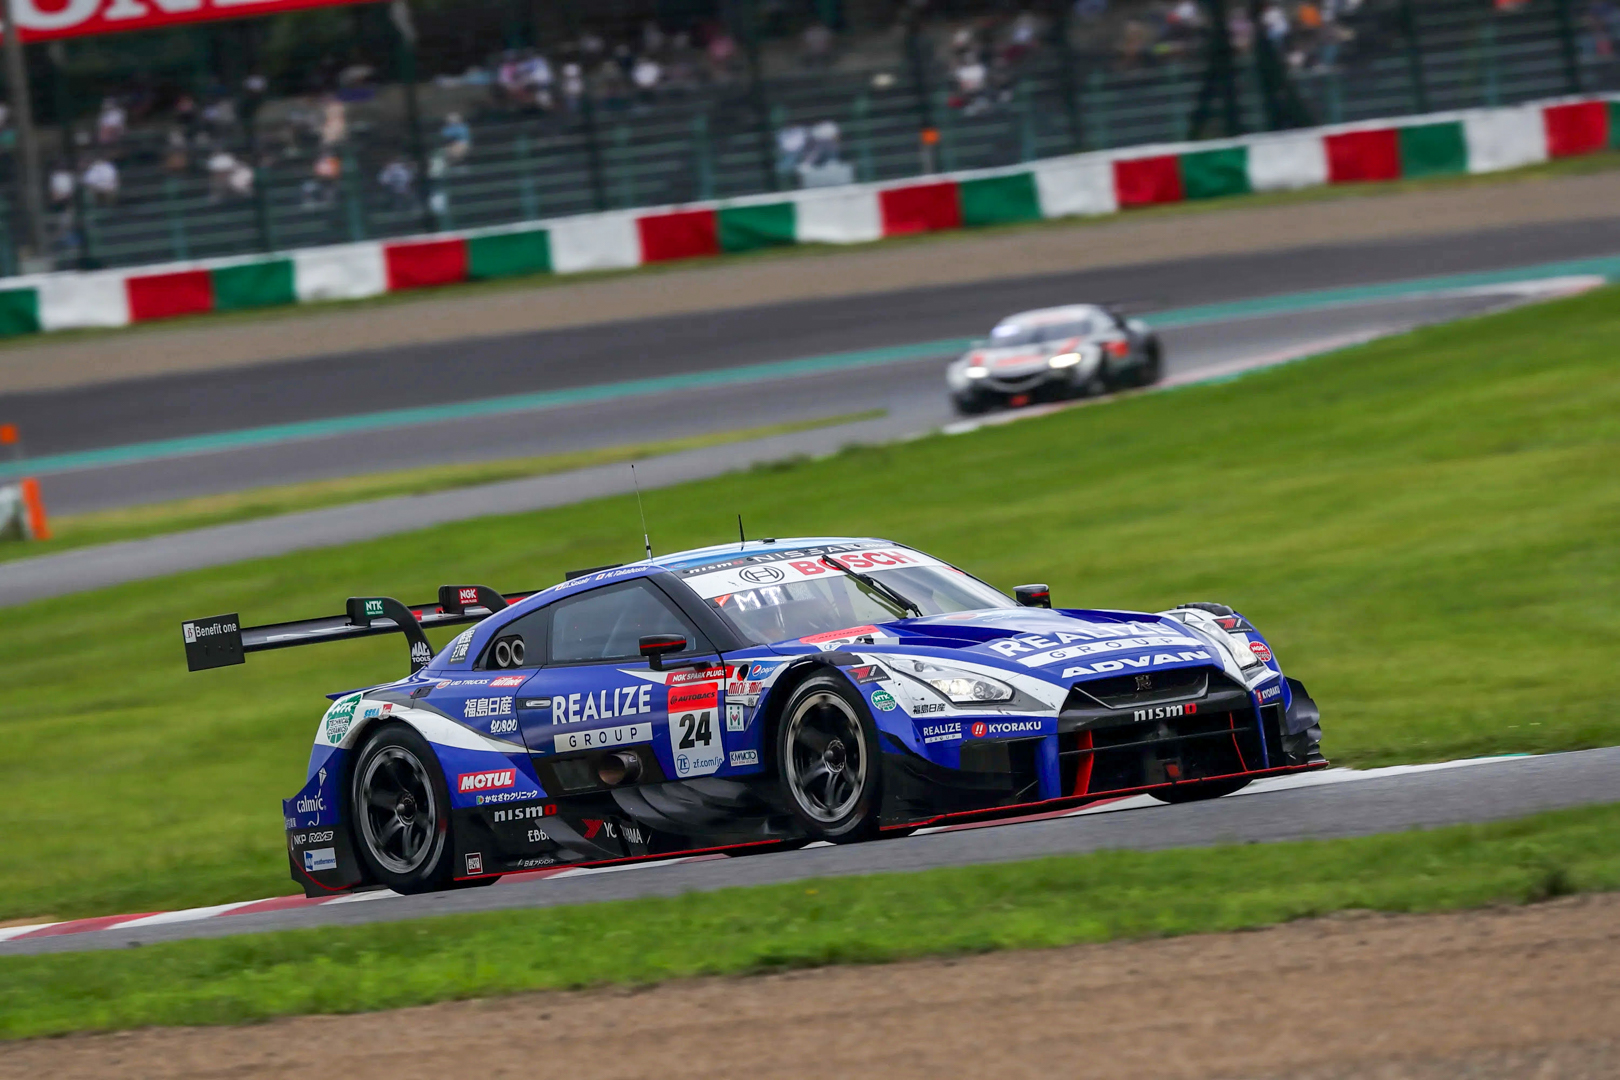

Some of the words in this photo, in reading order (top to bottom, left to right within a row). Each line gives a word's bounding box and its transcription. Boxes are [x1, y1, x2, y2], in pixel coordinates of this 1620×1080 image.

[689, 560, 744, 574] nismo
[787, 551, 919, 576] BOSCH
[460, 588, 477, 599] NGK
[365, 600, 383, 611] NTK
[195, 623, 222, 638] Benefit
[222, 622, 237, 633] one
[988, 621, 1181, 657] REALIZE
[411, 641, 431, 657] MAC
[1049, 638, 1173, 659] GROUP
[411, 655, 431, 663] TOOLS
[1061, 650, 1212, 679] ADVAN
[672, 674, 686, 683] NGK
[686, 670, 705, 680] SPARK
[705, 669, 727, 678] PLUGS
[552, 683, 653, 726] REALIZE
[677, 691, 716, 702] AUTOBACS
[874, 693, 891, 701] NTK
[332, 700, 357, 715] NTK
[463, 695, 513, 718] 福島日産
[1133, 702, 1197, 722] nismo
[679, 711, 712, 750] 24
[923, 722, 962, 737] REALIZE
[988, 720, 1042, 733] KYORAKU
[569, 727, 638, 748] GROUP
[693, 756, 723, 769] zf.com/jp
[460, 771, 513, 791] MOTUL
[296, 794, 324, 813] calmic
[485, 790, 538, 803] かなざわクリニック
[494, 804, 557, 822] nismo
[309, 831, 334, 843] RAYS
